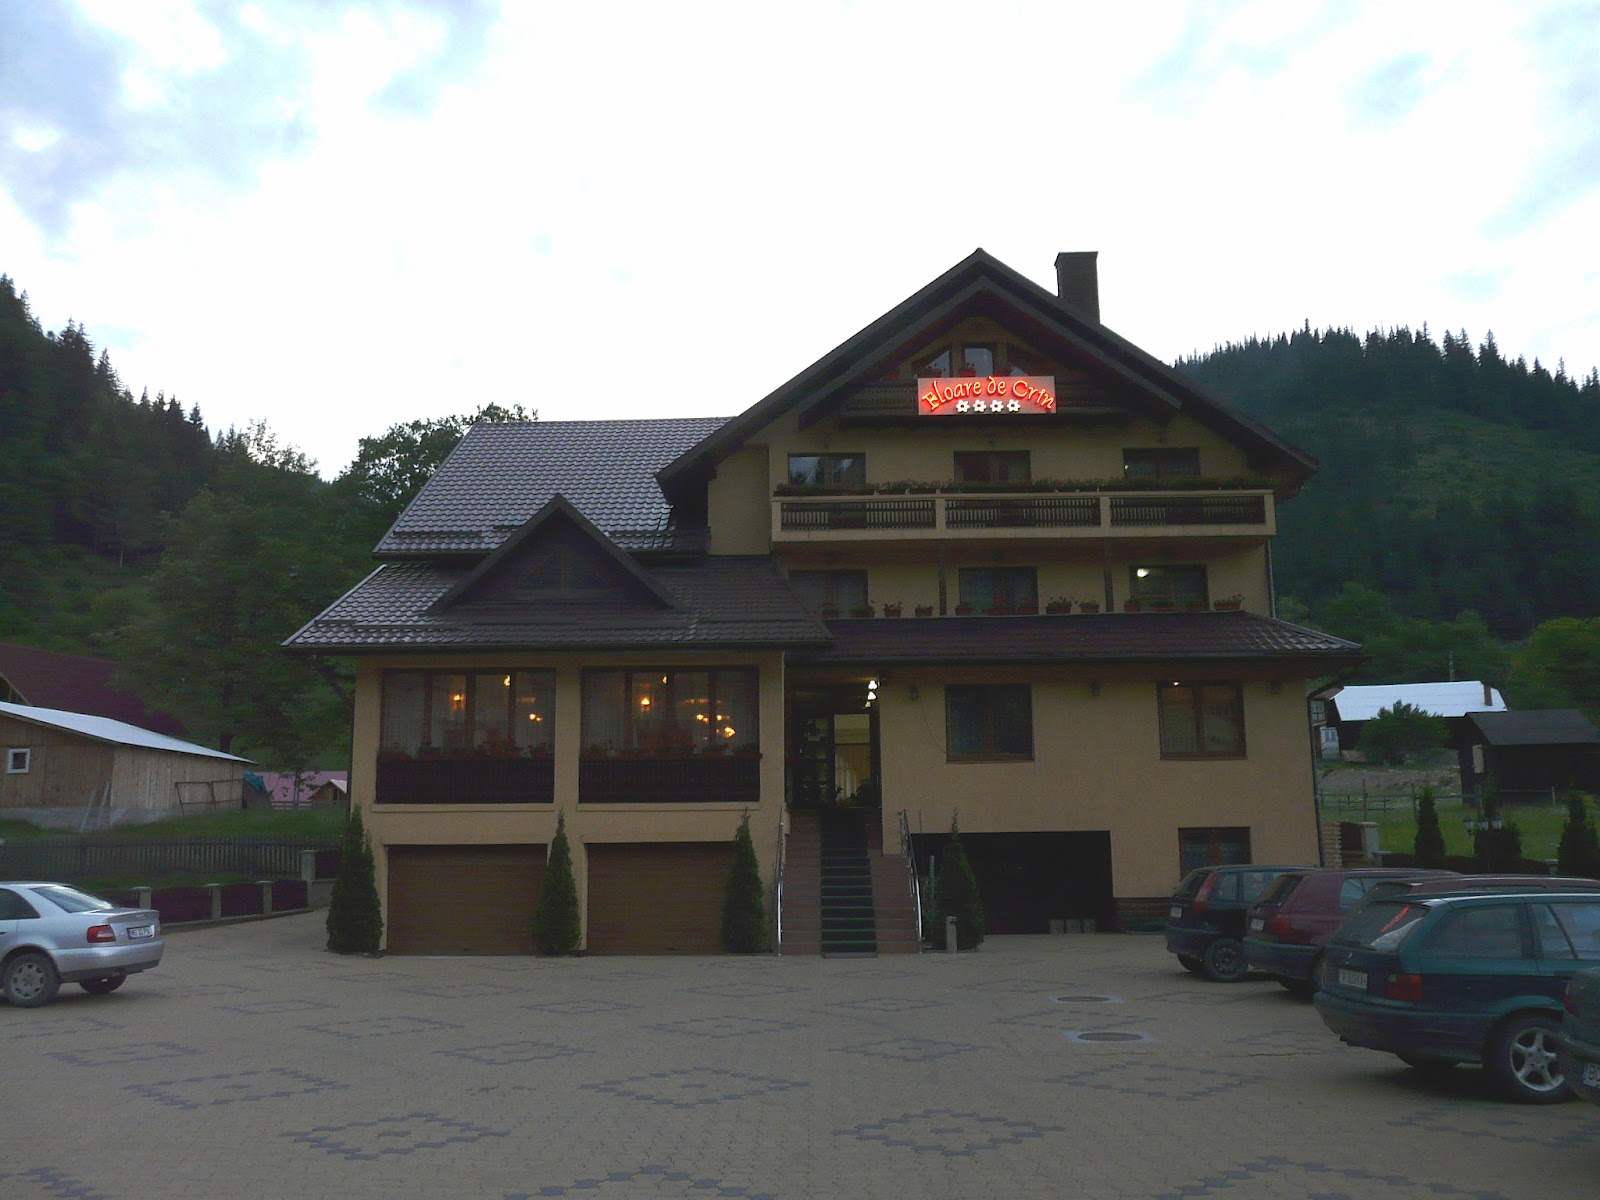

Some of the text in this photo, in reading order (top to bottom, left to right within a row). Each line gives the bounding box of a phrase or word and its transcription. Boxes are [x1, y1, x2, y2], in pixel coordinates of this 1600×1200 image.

[922, 376, 1055, 411] Floare de Crin
